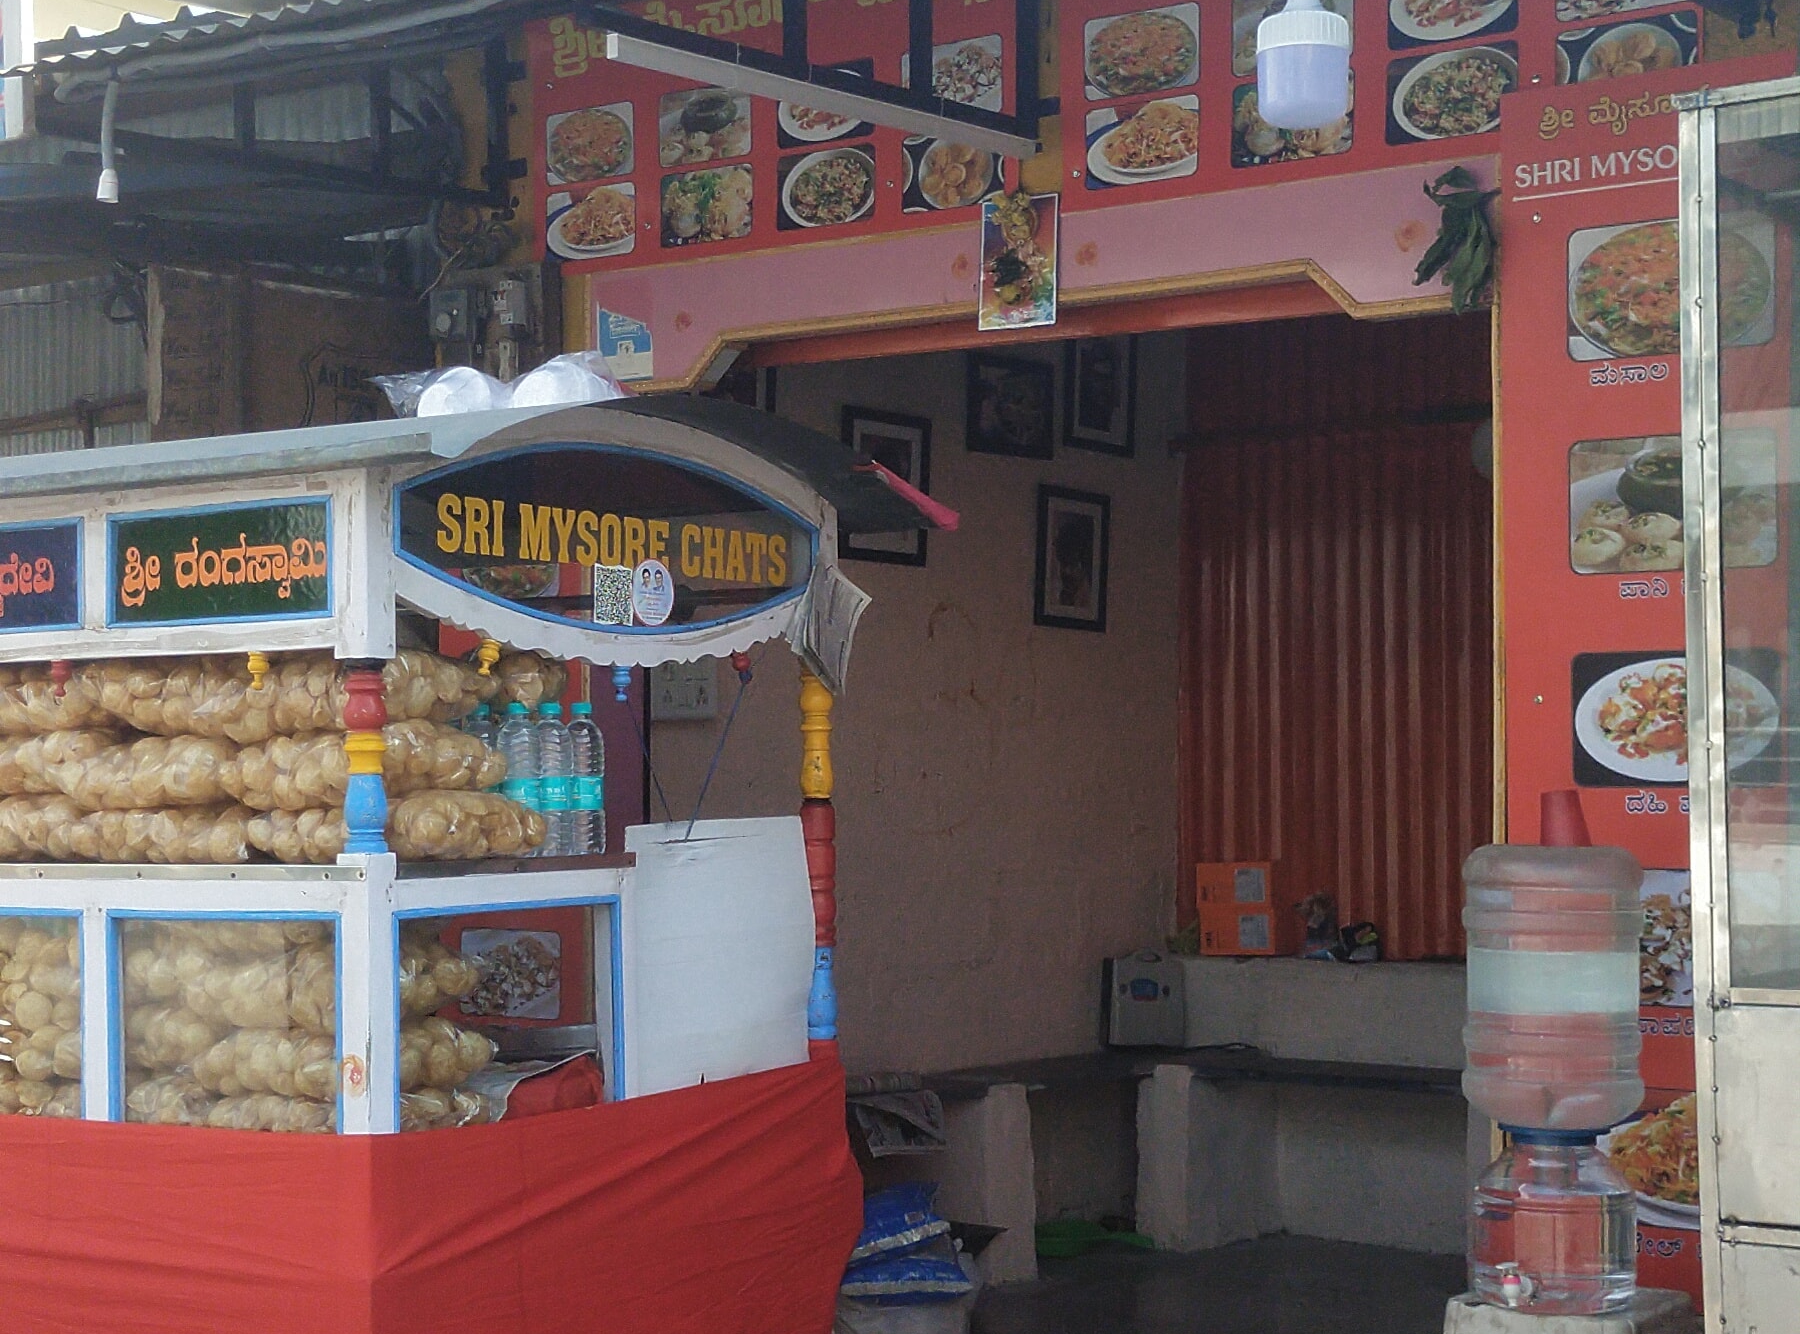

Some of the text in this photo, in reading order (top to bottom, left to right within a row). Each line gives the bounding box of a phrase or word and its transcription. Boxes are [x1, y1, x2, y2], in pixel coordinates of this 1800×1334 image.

[1538, 91, 1675, 140] ಶ್ರೀ ಮೈಸೂ
[1514, 144, 1679, 188] SHRI MYSO
[121, 531, 327, 608] ಶ್ರೀ ರಂಗಸ್ವಾಮಿ
[436, 492, 787, 588] SRI MYSORE CHATS
[0, 552, 55, 618] ದೇವಿ
